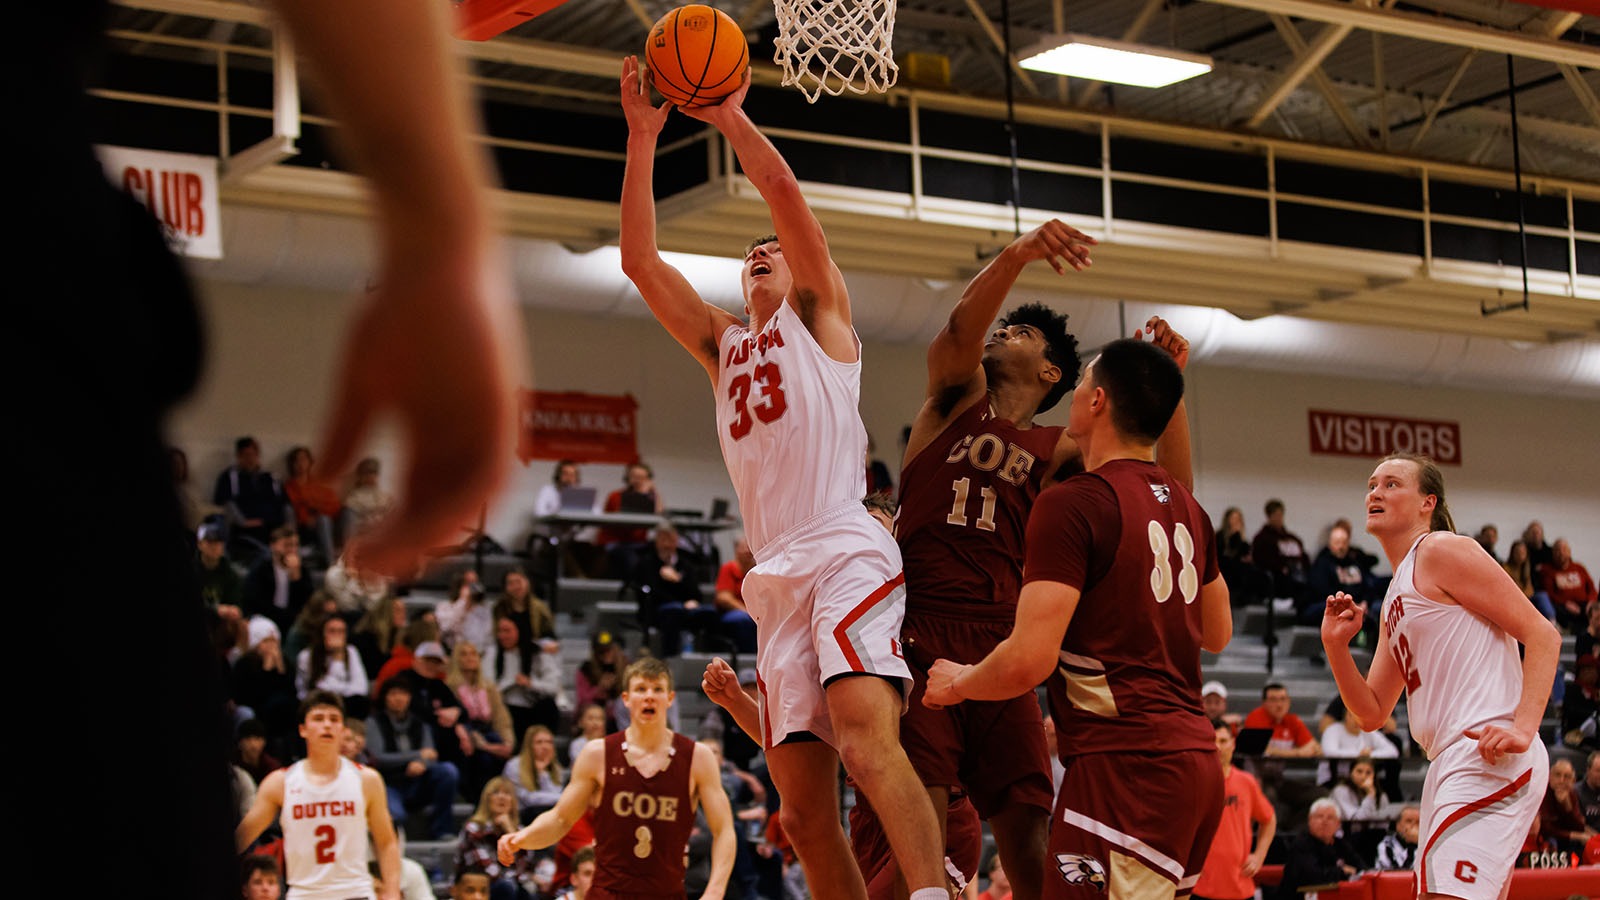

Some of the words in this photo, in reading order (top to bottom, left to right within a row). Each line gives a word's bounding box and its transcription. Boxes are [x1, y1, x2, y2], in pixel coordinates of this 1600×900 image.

[728, 361, 788, 442] 33
[1313, 415, 1456, 460] VISITORS
[946, 433, 1036, 487] COE
[946, 476, 997, 532] 11
[293, 801, 355, 820] DUTCH
[613, 791, 679, 821] COE
[314, 824, 336, 864] 2
[1530, 851, 1569, 869] POSS
[1454, 860, 1478, 884] C
